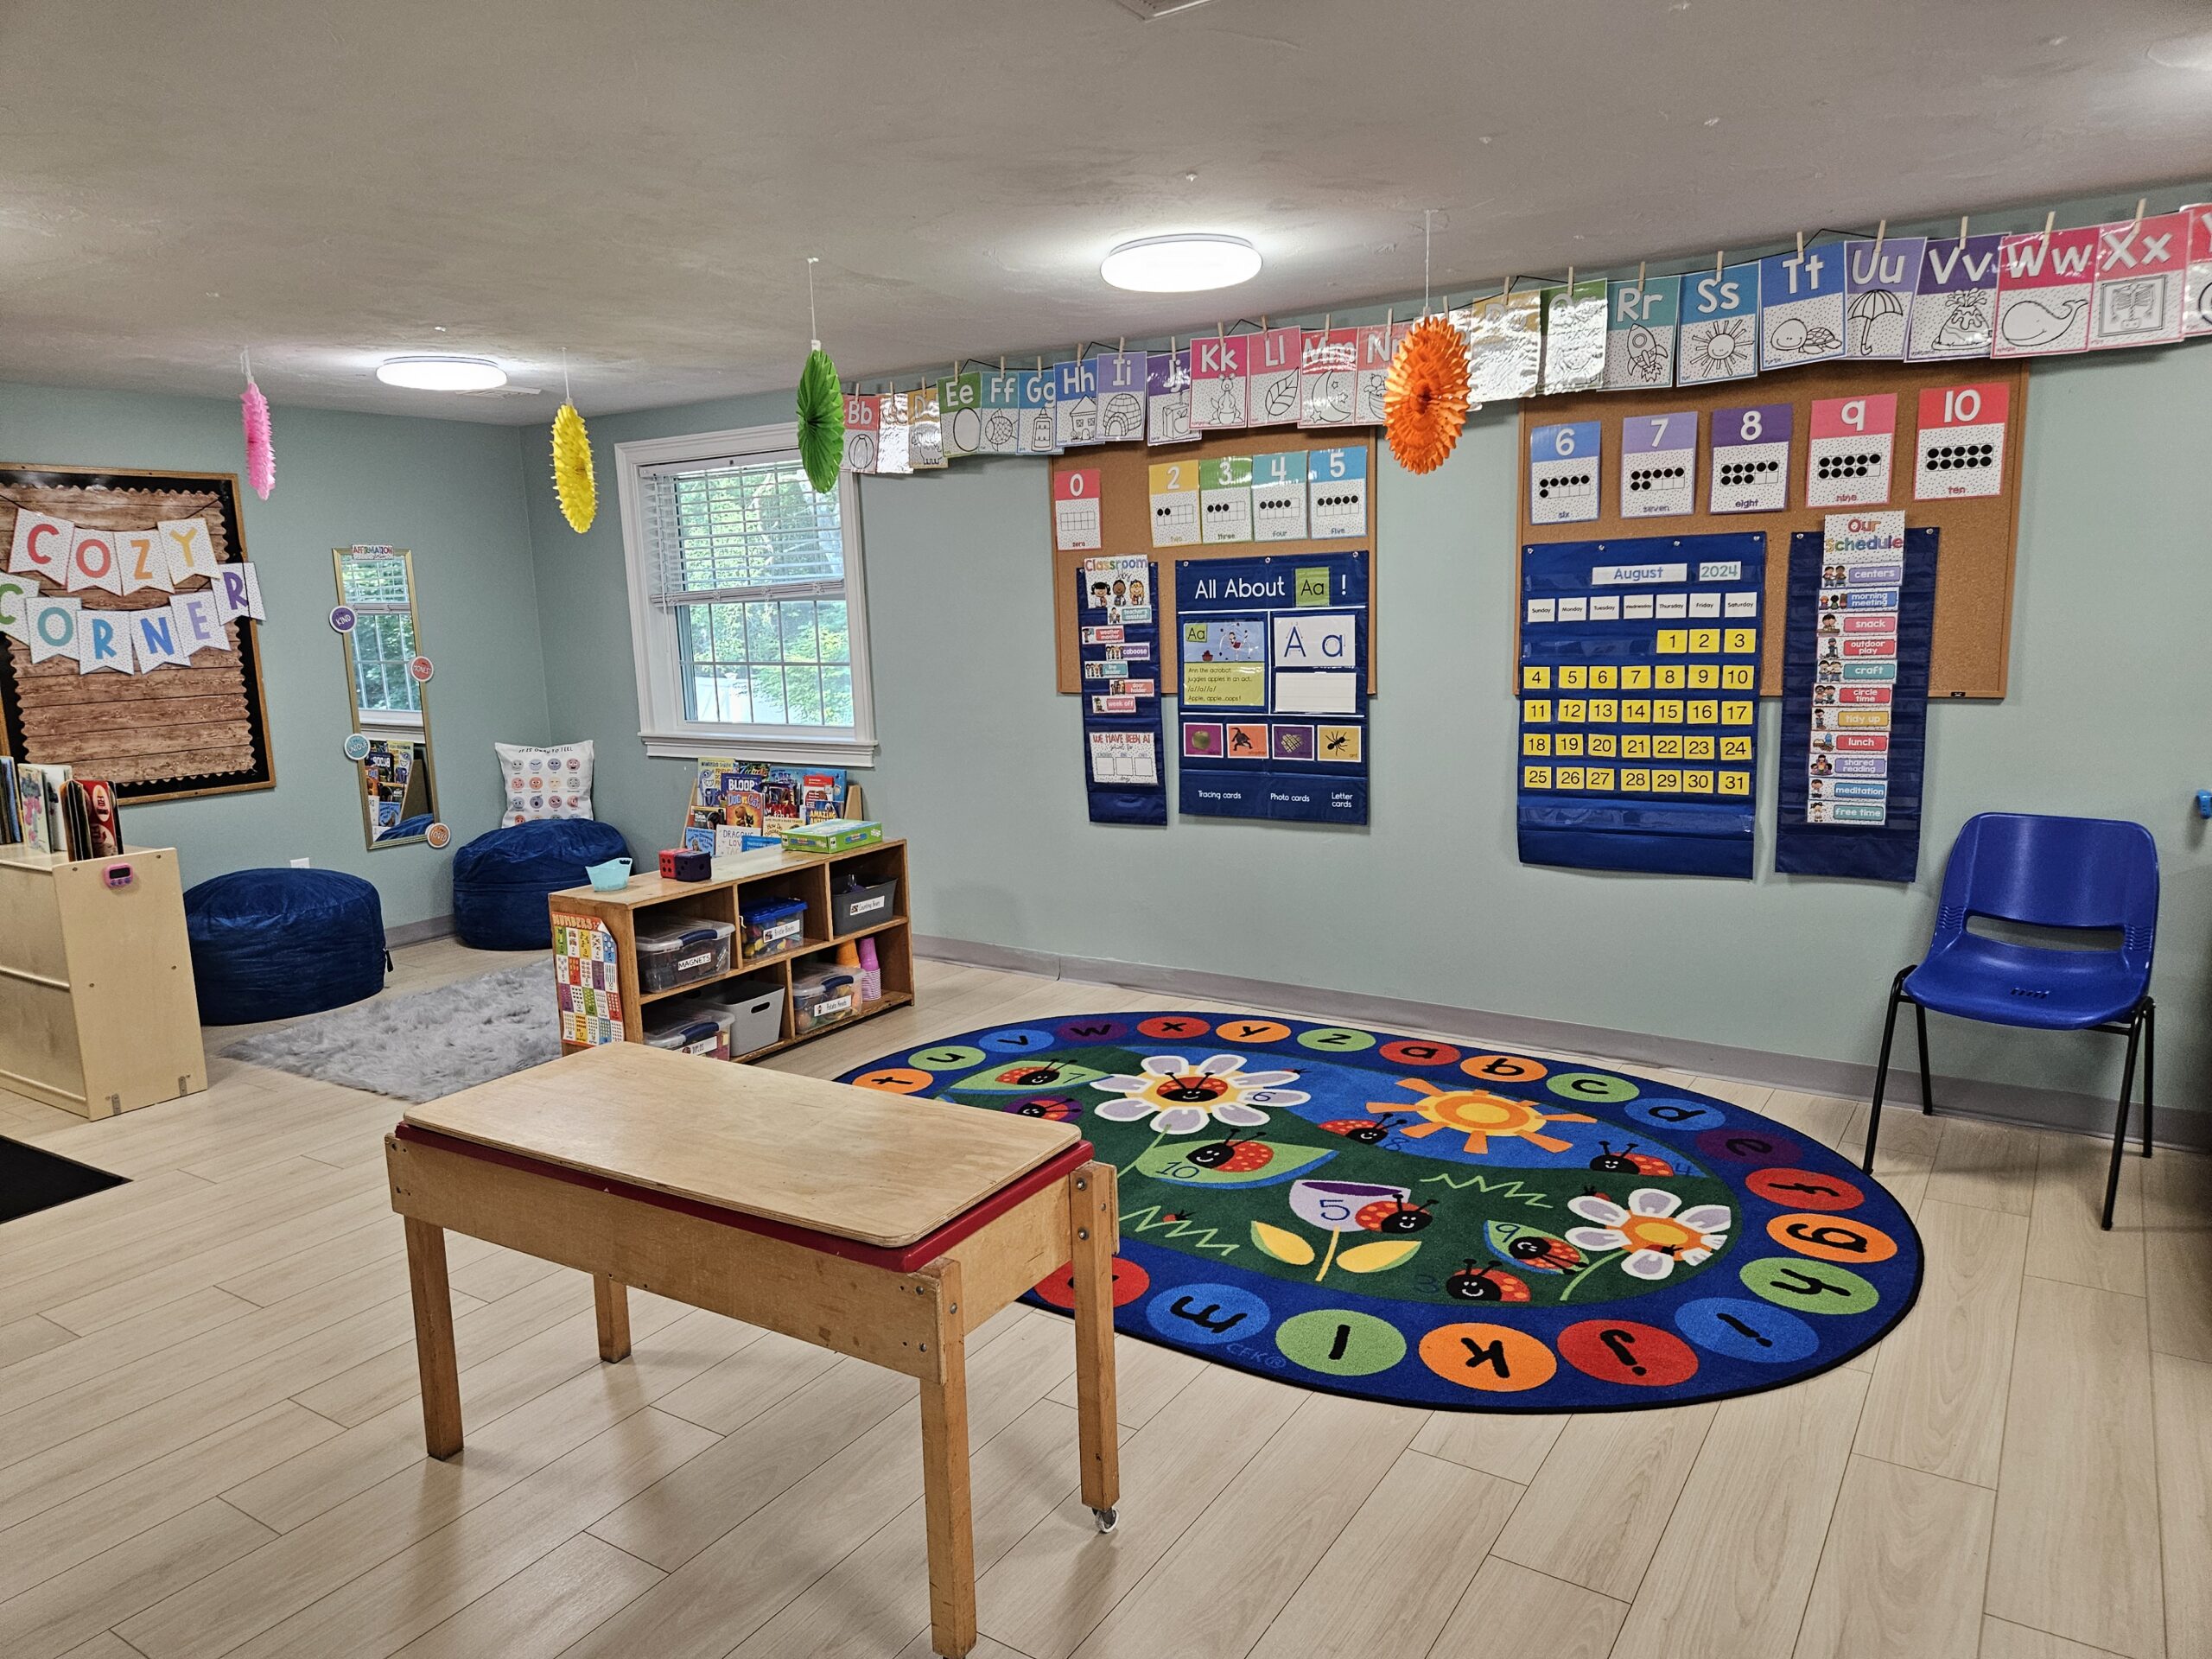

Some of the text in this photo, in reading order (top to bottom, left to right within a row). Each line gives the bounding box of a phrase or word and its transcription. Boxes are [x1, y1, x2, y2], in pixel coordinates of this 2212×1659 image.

[2006, 243, 2093, 278] Ww
[2101, 232, 2173, 272] Xx
[1852, 249, 1904, 285] Uu
[1929, 245, 1993, 284] Vv
[1782, 255, 1824, 294] Tt
[1617, 287, 1663, 322] Rr
[1697, 278, 1739, 314] Ss
[1201, 343, 1238, 372] Kk
[1264, 335, 1285, 366] Ll
[1302, 337, 1356, 366] Mm
[1063, 365, 1094, 394] Hh
[1112, 359, 1131, 386] Ii
[1163, 359, 1182, 392] Jj
[946, 380, 974, 407] Ee
[990, 377, 1016, 403] Ff
[1027, 377, 1055, 408] Gg
[848, 400, 873, 425] Bb
[1840, 400, 1866, 431] 9
[1944, 390, 1981, 423] 10
[1649, 418, 1669, 448] 7
[1740, 410, 1763, 442] 8
[1555, 428, 1575, 456] 6
[1218, 461, 1233, 486] 3
[1271, 456, 1286, 481] 4
[1330, 452, 1345, 477] 5
[1070, 474, 1084, 497] 0
[1166, 466, 1180, 490] 2
[1836, 493, 1858, 503] nine
[1948, 486, 1967, 494] ten
[1735, 499, 1758, 509] eight
[1847, 518, 1881, 532] Our
[27, 524, 198, 580] COZY
[1085, 558, 1147, 571] Classroom
[1613, 566, 1664, 582] August
[1700, 564, 1738, 578] 2024
[1854, 569, 1895, 579] centers
[1195, 574, 1347, 599] All About Aa !
[0, 571, 249, 659] CORNER
[335, 614, 352, 626] KIND
[1855, 620, 1885, 628] snack
[1187, 627, 1205, 640] Aa
[1284, 626, 1343, 658] A a
[1670, 634, 1745, 648] 1 2 3
[1531, 670, 1748, 683] 4 5 6 7 8 9 10
[1531, 704, 1747, 719] 11 12 13 14 15 16 17
[1846, 715, 1865, 723] tidy
[1093, 734, 1103, 743] WE
[1106, 734, 1123, 743] HAVE
[1529, 738, 1745, 755] 18 19 20 21 22 23 24
[1848, 738, 1874, 747] lunch
[728, 779, 755, 791] BLOOP
[1529, 771, 1744, 790] 25 26 27 28 29 30 31
[1198, 790, 1221, 800] Tracing
[1270, 792, 1310, 803] Photo cards
[1332, 791, 1353, 801] Letter
[1835, 786, 1884, 795] meditation
[553, 914, 593, 930] NUMBERS
[679, 954, 710, 969] MAGNETS
[1070, 1024, 1112, 1039] w
[1160, 1021, 1187, 1032] x
[1239, 1026, 1271, 1037] y
[1000, 1034, 1028, 1046] v
[1317, 1033, 1351, 1045] z
[925, 1052, 966, 1064] u
[1400, 1046, 1439, 1058] a
[1484, 1058, 1525, 1077] b
[871, 1076, 913, 1086] t
[1062, 1071, 1087, 1085] 7
[1571, 1078, 1608, 1095] c
[1252, 1091, 1277, 1102] 6
[1649, 1106, 1707, 1122] d
[1383, 1136, 1412, 1154] 8
[1726, 1138, 1773, 1156] e
[1155, 1161, 1200, 1180] 10
[1675, 1162, 1694, 1176] 4
[1768, 1182, 1840, 1197] f
[1319, 1199, 1351, 1221] 5
[1496, 1223, 1522, 1242] 9
[1786, 1223, 1867, 1253] g
[1414, 1274, 1440, 1294] 3
[1770, 1268, 1852, 1296] h
[1716, 1313, 1773, 1348] i
[1460, 1337, 1510, 1378] k
[1599, 1329, 1647, 1376] j
